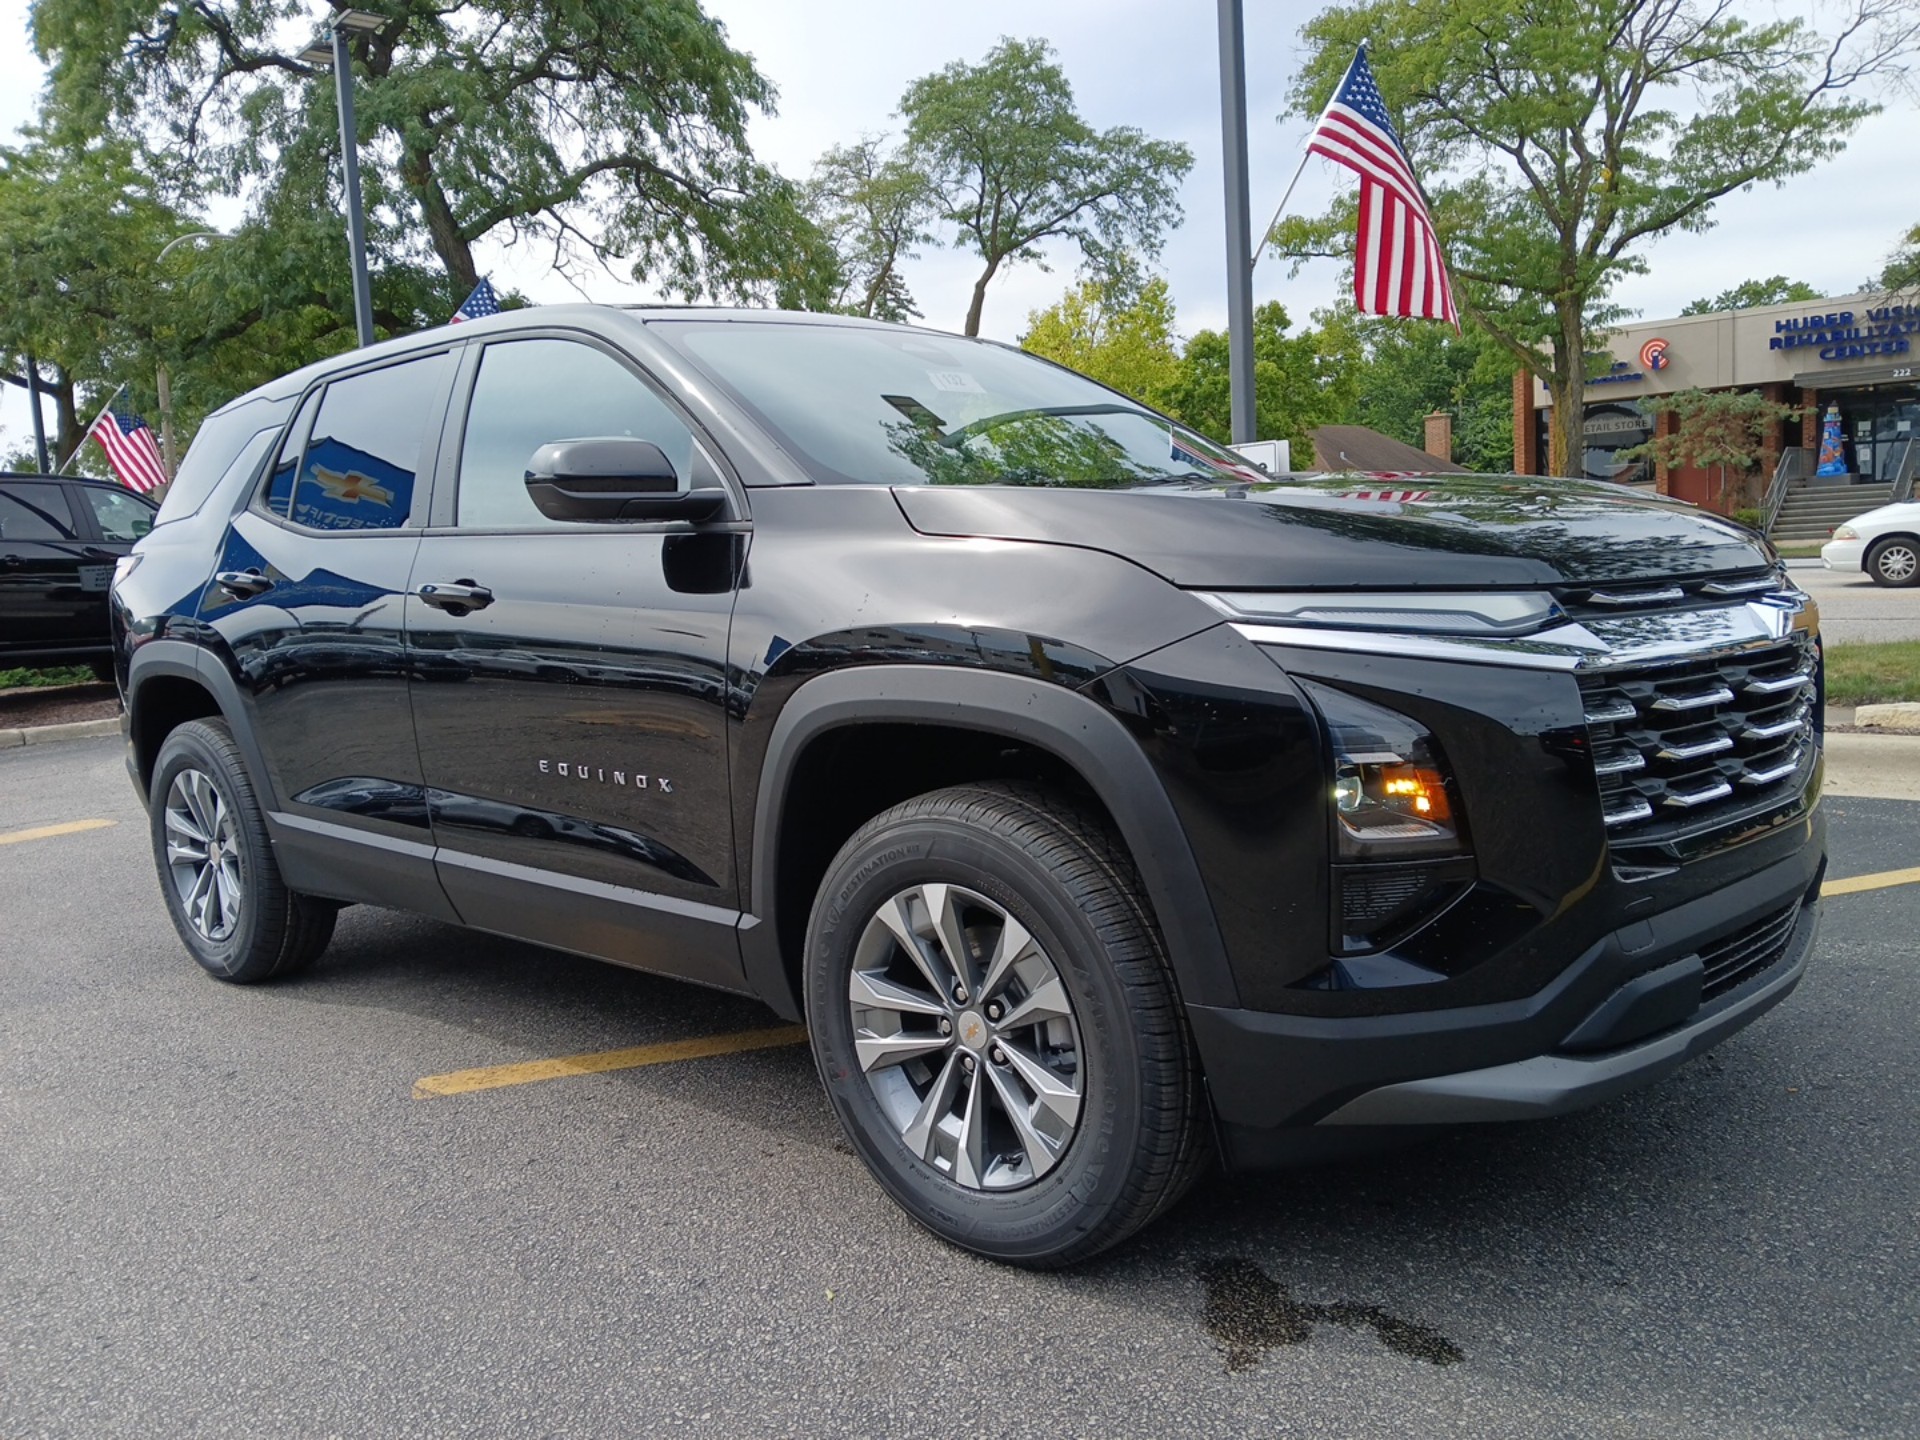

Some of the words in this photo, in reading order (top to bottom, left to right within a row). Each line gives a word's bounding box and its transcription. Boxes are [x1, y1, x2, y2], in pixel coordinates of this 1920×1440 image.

[1775, 311, 1854, 333] HUBER
[1819, 339, 1910, 361] CENTER
[1893, 368, 1911, 377] 222
[1584, 422, 1611, 433] ETAIL
[1615, 420, 1647, 430] STORE
[539, 759, 673, 793] EQUINOX
[840, 847, 906, 902] DESTINATION
